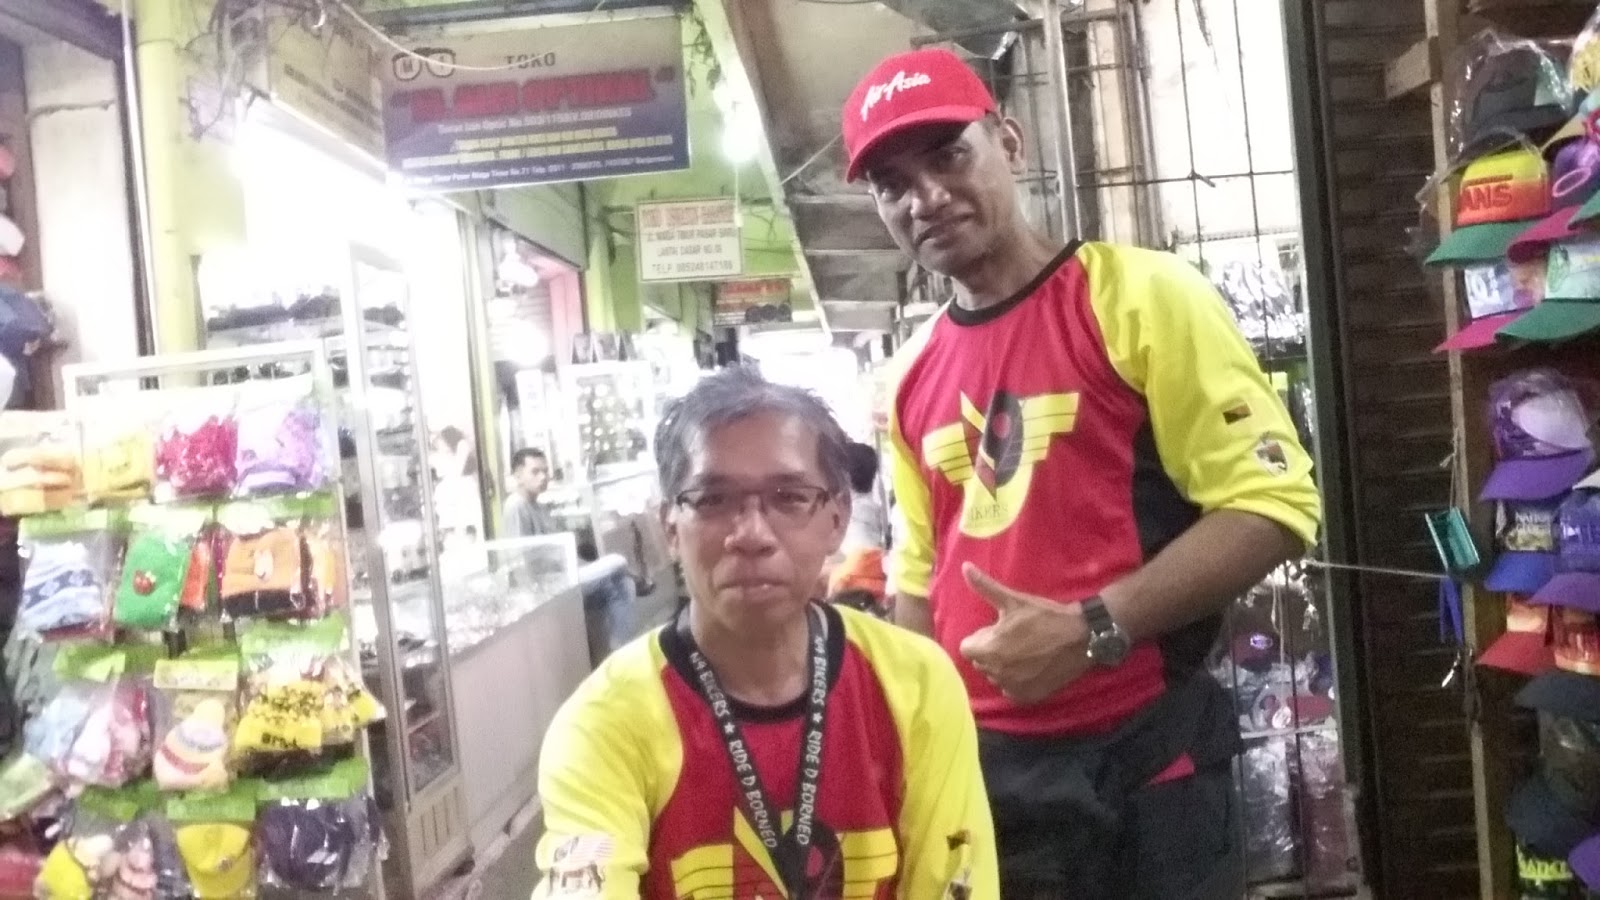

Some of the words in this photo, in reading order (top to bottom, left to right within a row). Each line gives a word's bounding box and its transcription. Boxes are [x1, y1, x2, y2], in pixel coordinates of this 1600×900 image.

[506, 52, 556, 70] TOKO
[811, 656, 827, 706] BIKERS
[806, 730, 823, 764] RIDE
[729, 739, 752, 773] RIDE
[745, 789, 778, 848] BORNEO
[796, 782, 817, 845] BORNEO
